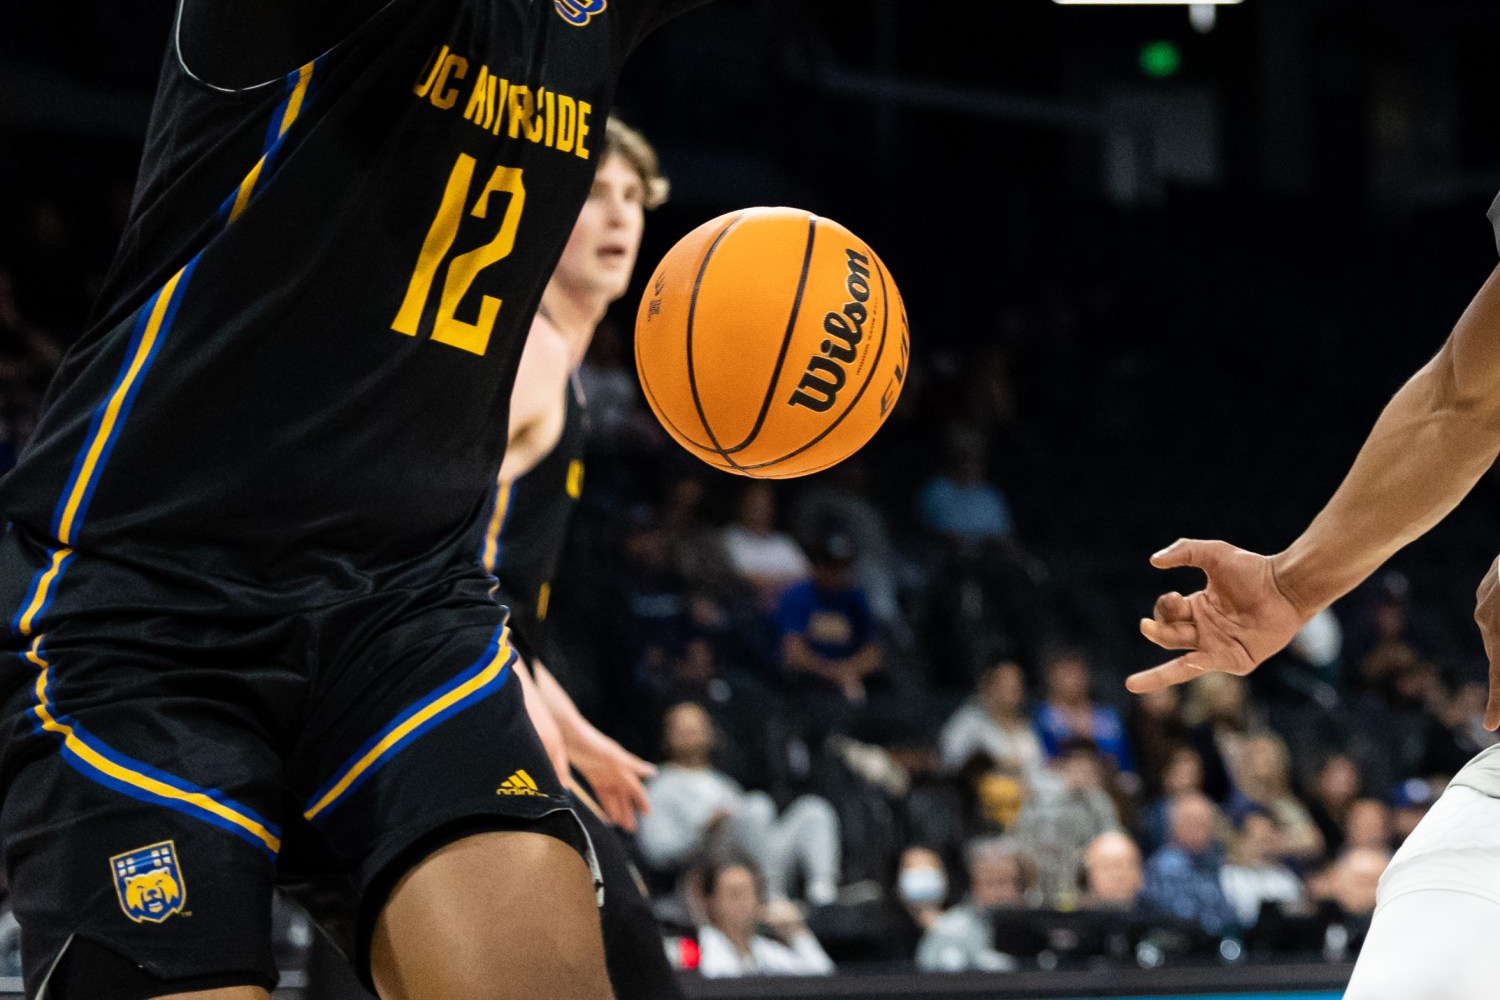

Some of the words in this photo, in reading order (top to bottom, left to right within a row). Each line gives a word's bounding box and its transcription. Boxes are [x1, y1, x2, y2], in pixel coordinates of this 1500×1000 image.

[463, 64, 592, 160] RIRSIDE
[390, 152, 526, 356] 12
[787, 248, 870, 412] Wilson
